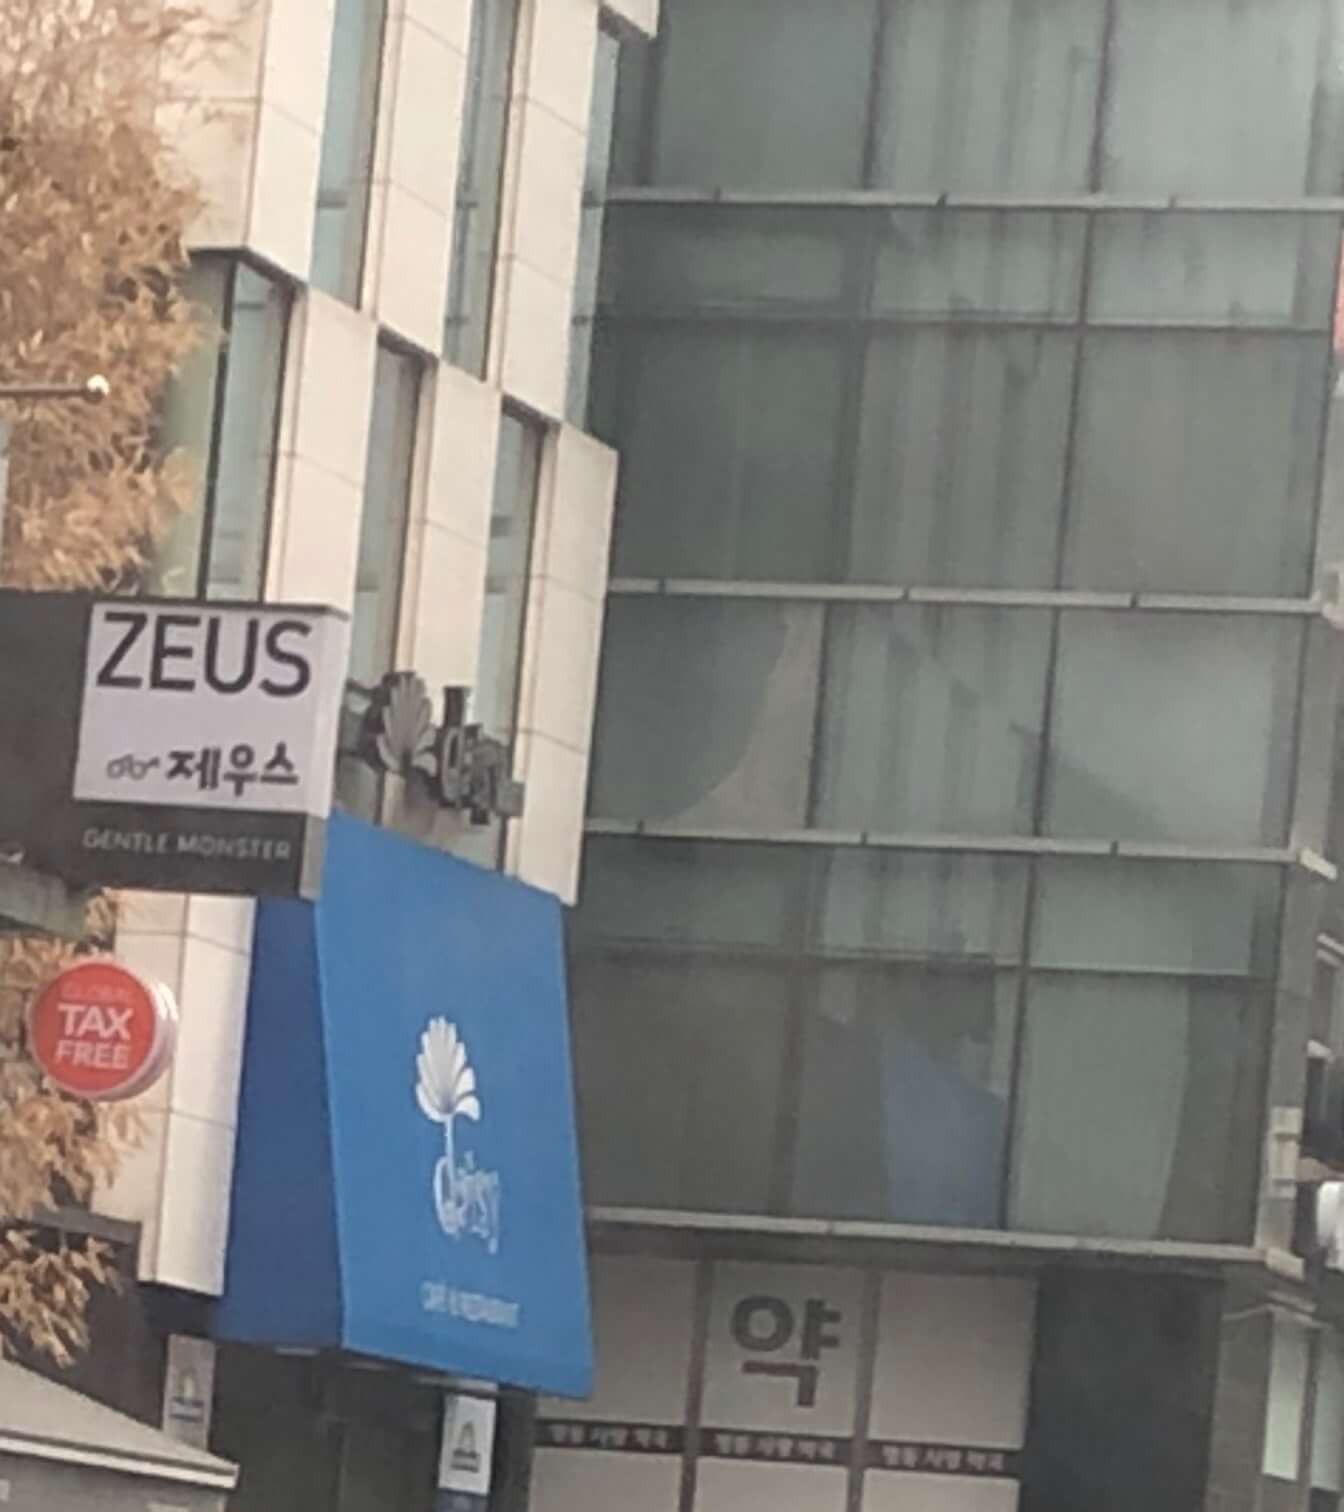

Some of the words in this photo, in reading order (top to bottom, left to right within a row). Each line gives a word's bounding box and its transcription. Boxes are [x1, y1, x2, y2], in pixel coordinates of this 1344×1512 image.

[96, 611, 312, 698] ZEUS
[165, 741, 299, 797] 제우스
[82, 827, 170, 855] GENTLE
[176, 832, 292, 861] MONSTER
[57, 1002, 134, 1041] TAX
[53, 1038, 131, 1070] FREE
[730, 1295, 842, 1408] 약
